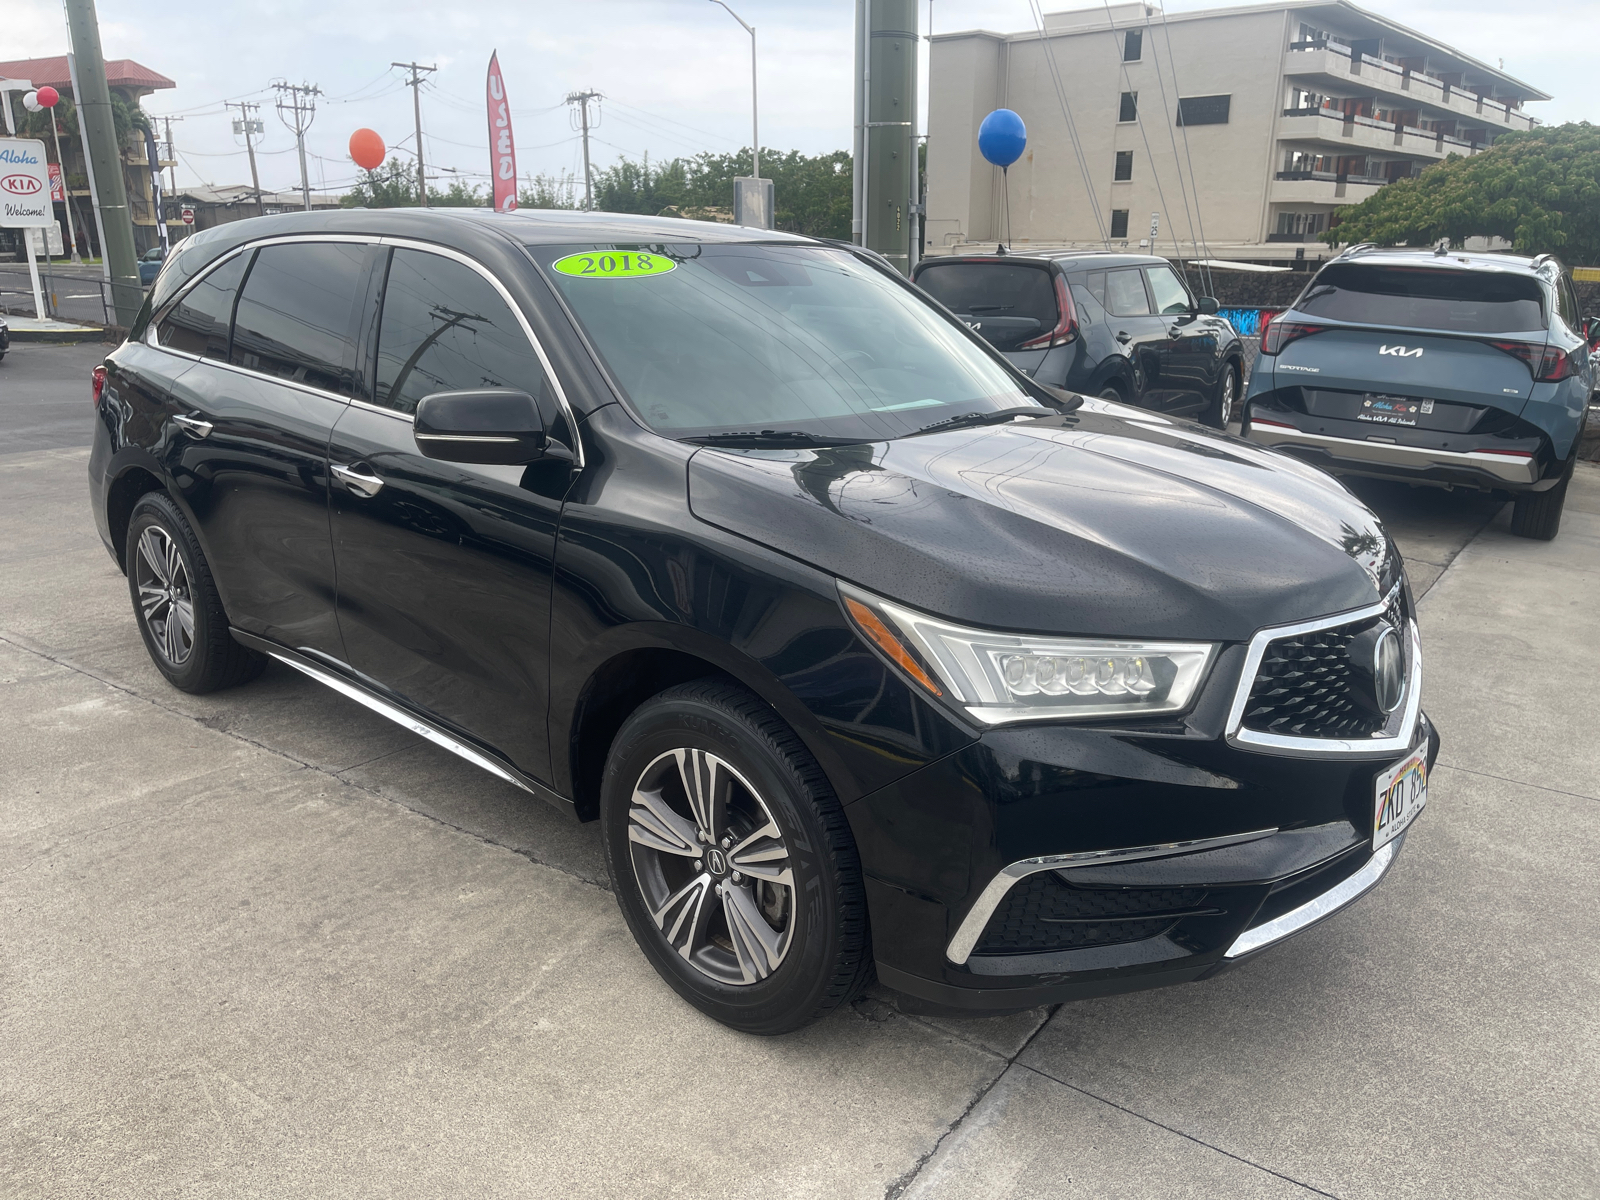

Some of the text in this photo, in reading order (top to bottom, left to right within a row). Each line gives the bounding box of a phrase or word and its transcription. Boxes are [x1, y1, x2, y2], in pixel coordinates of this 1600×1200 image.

[490, 74, 514, 181] USED
[0, 149, 39, 165] Aloha
[8, 179, 36, 190] KIA
[4, 203, 46, 217] Welcome!
[578, 254, 654, 274] 2018
[1378, 344, 1424, 358] KIA
[1279, 364, 1321, 373] SPORTAGE
[1378, 779, 1404, 831] ZKD
[1391, 816, 1406, 832] ALOHA
